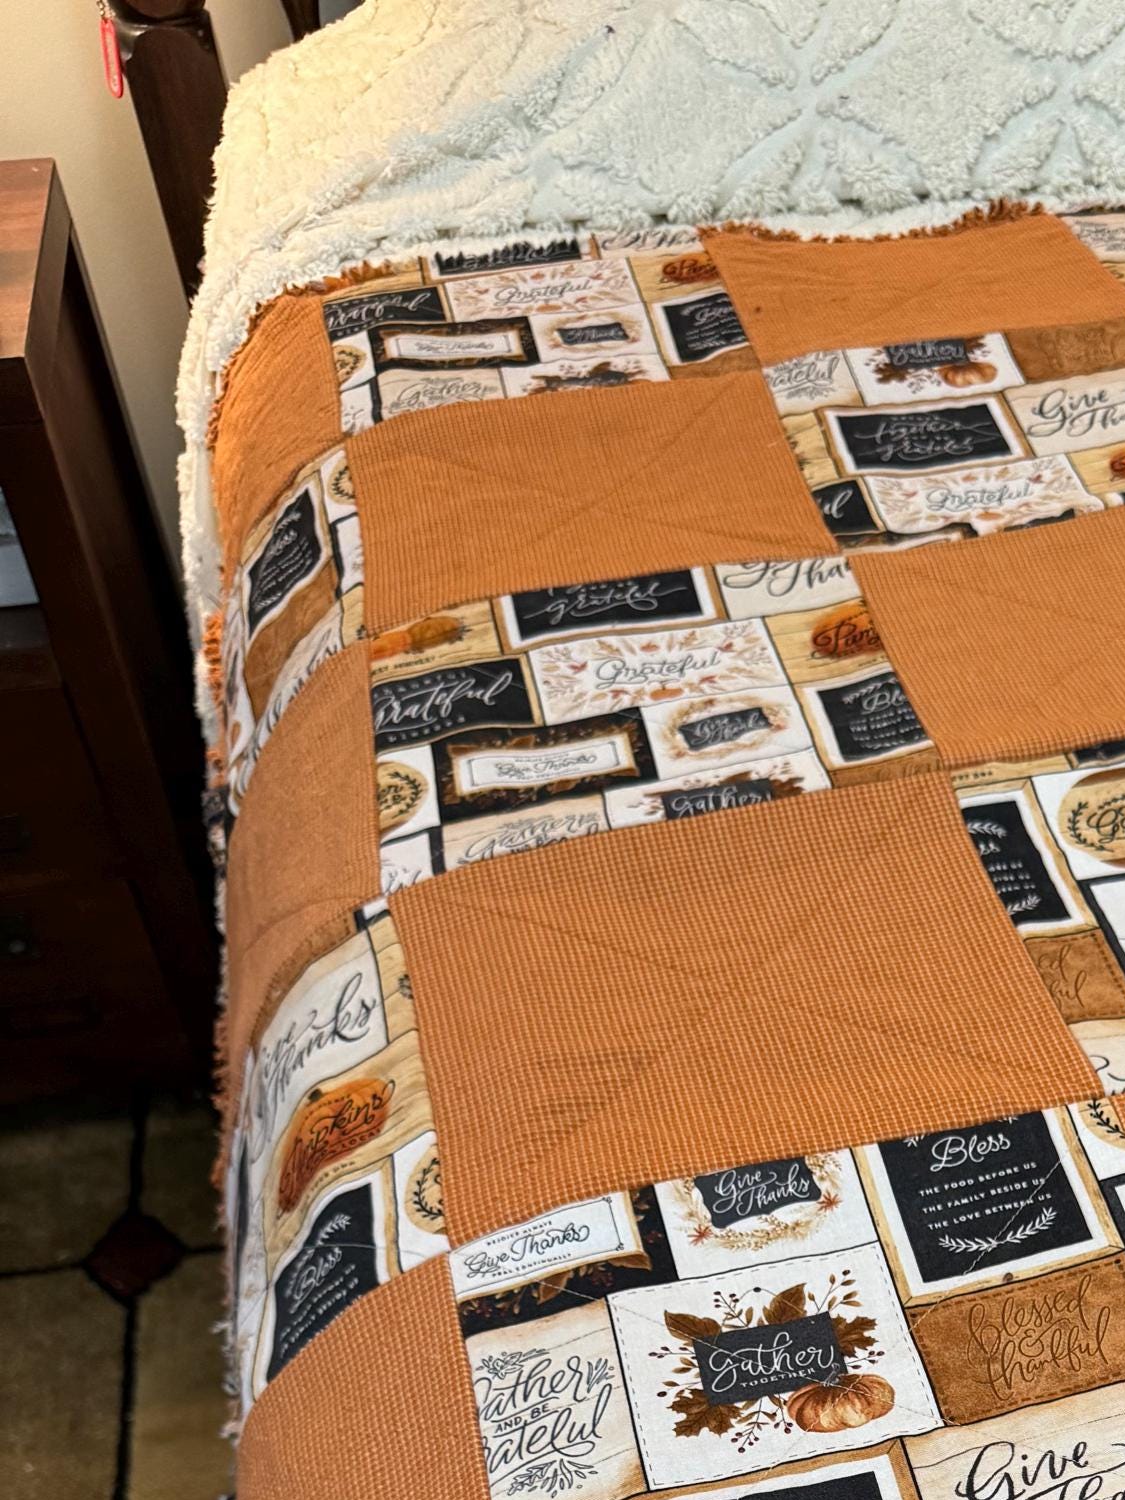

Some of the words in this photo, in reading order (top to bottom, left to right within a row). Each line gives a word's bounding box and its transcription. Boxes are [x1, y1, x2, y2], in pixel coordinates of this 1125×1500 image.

[926, 482, 1034, 512] Grateful
[596, 651, 722, 690] Grateful
[929, 1132, 1012, 1172] Bless
[713, 1170, 778, 1213] Give
[736, 1163, 810, 1218] Thanks
[918, 1185, 940, 1198] THE
[944, 1178, 975, 1193] FOOD
[977, 1167, 1021, 1184] BEFORE
[1023, 1161, 1038, 1171] US
[922, 1203, 944, 1215] THE
[946, 1191, 987, 1211] FAMILY
[990, 1180, 1028, 1196] BESIDE
[1032, 1176, 1046, 1187] US
[927, 1220, 949, 1232] THE
[953, 1210, 982, 1225] LOVE
[985, 1198, 1035, 1216] BETWEEN
[1037, 1192, 1053, 1202] US
[464, 1252, 510, 1279] Give
[511, 1222, 590, 1261] Thanks
[289, 1247, 342, 1314] Bless
[967, 1274, 1092, 1355] blessed
[973, 1306, 1110, 1400] thankful
[740, 1368, 816, 1388] TOGETHER
[495, 1416, 523, 1433] AND
[530, 1403, 550, 1419] BE
